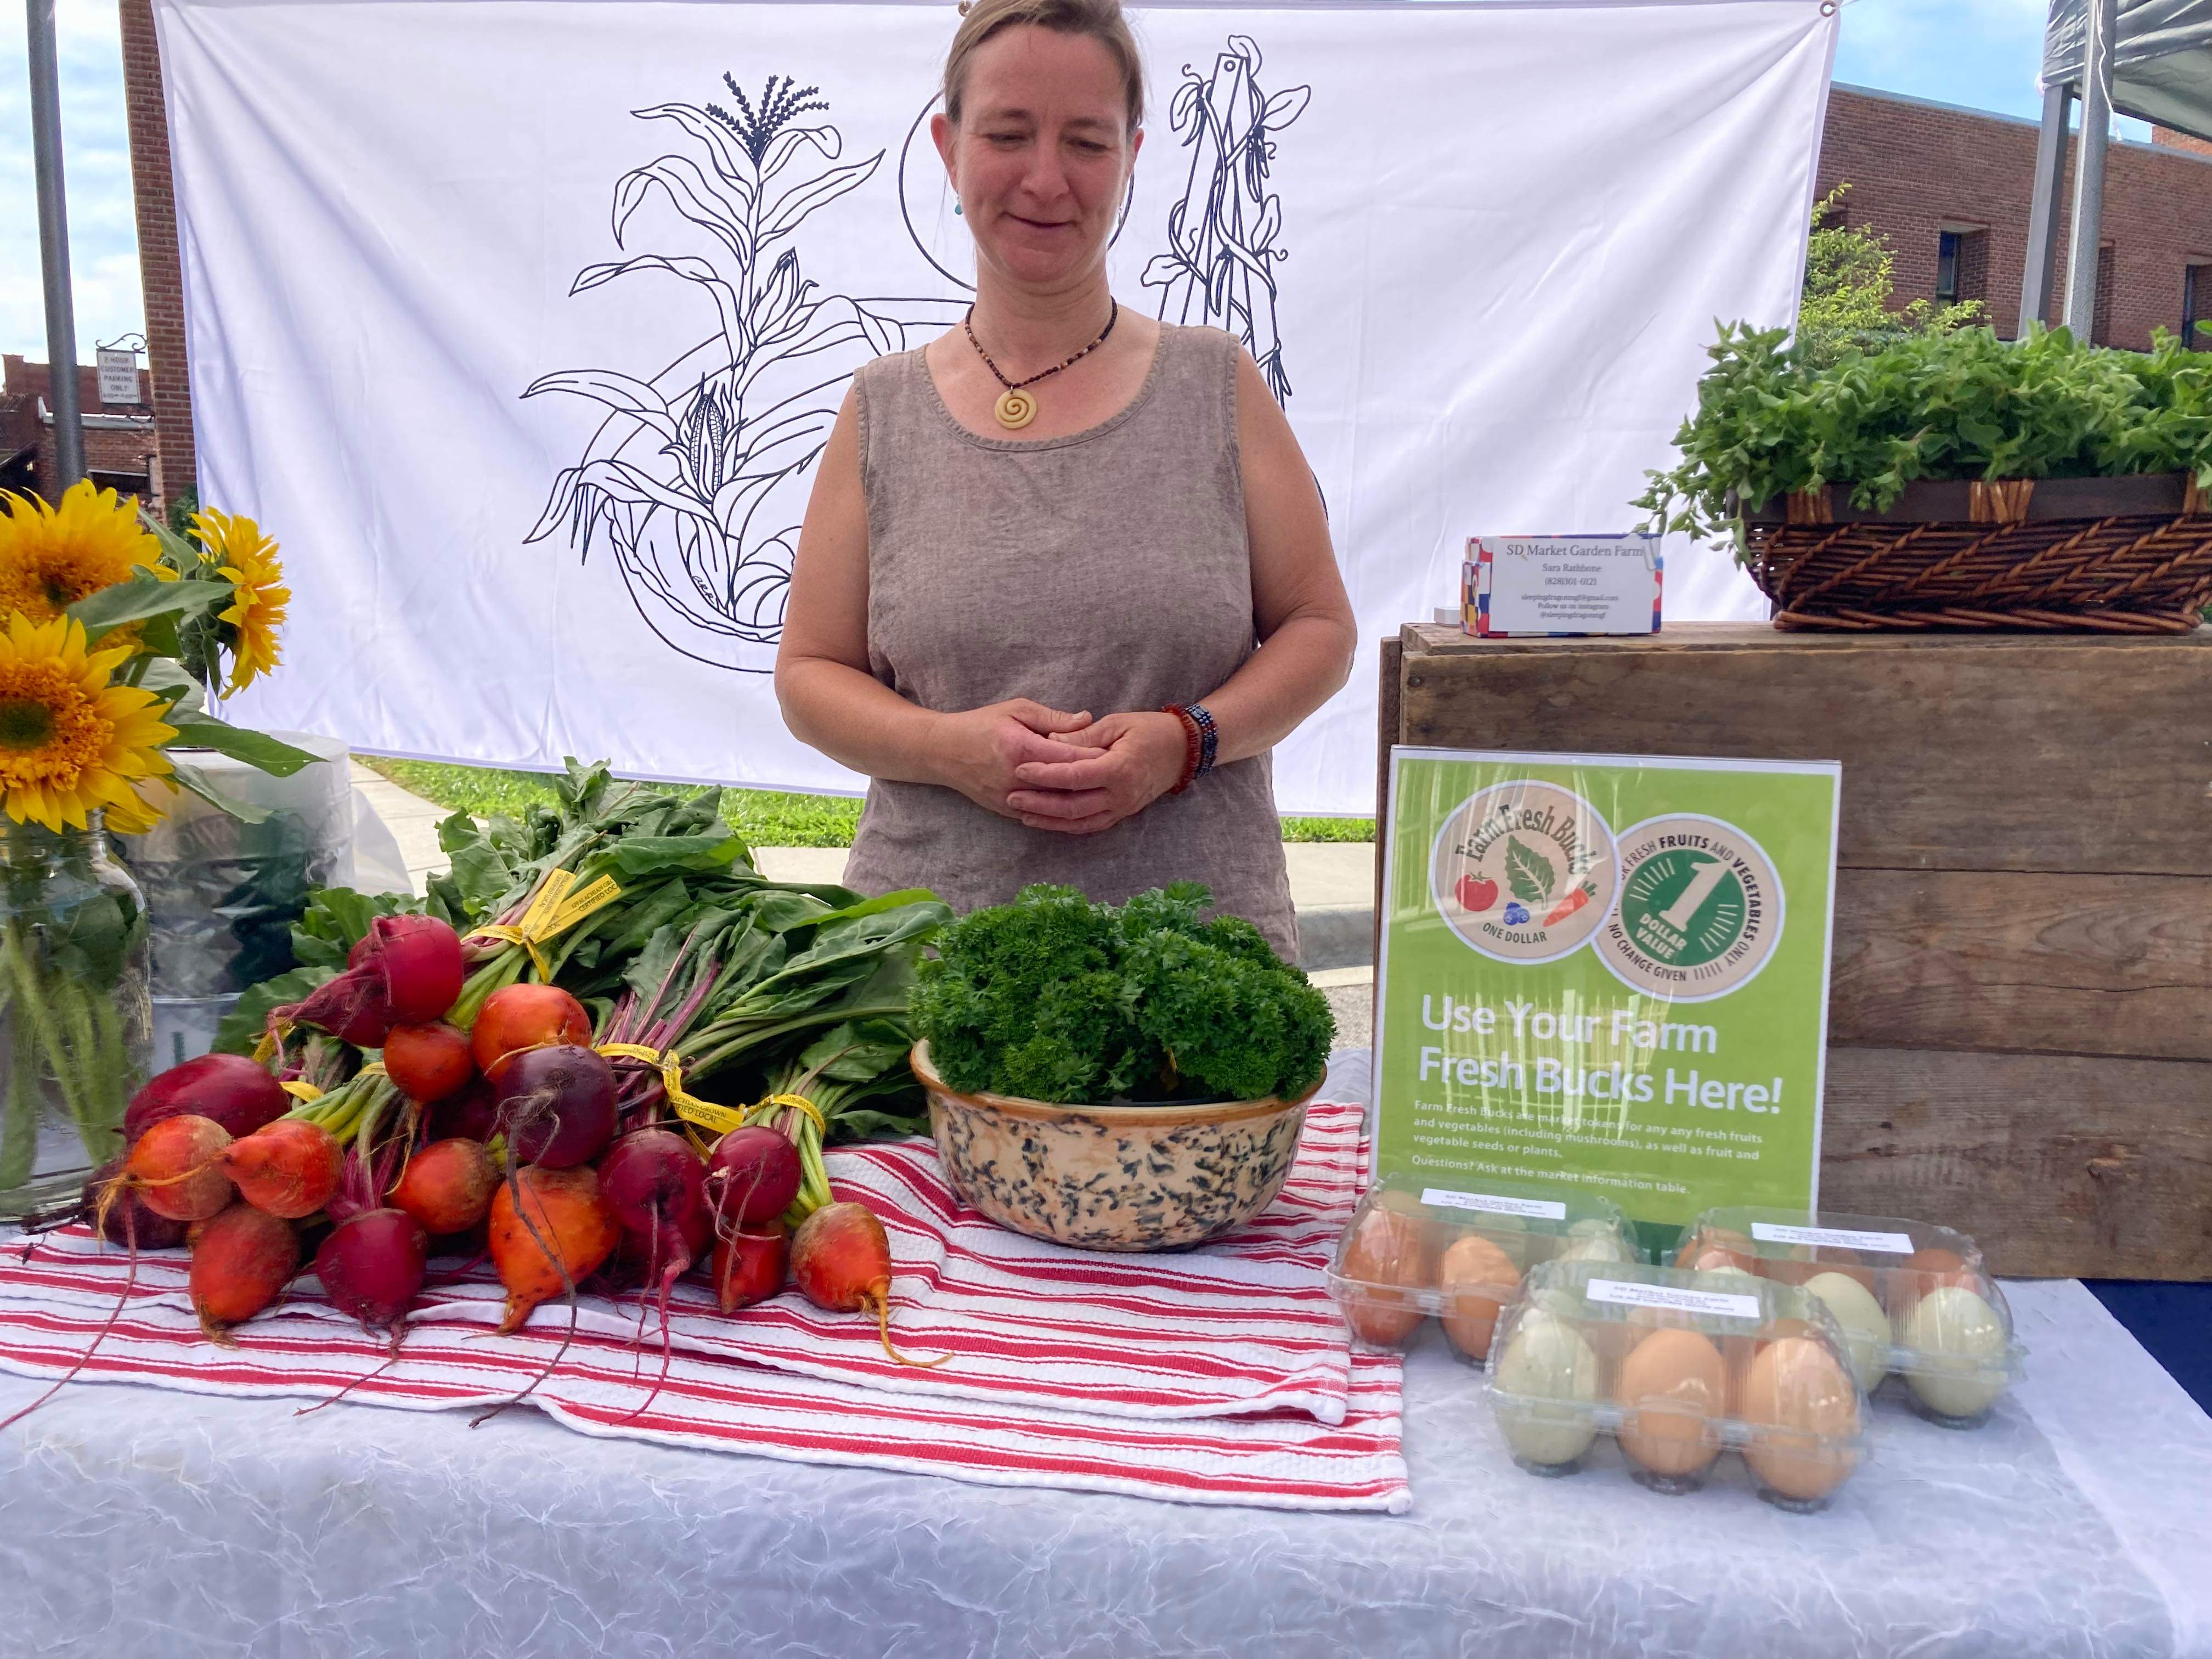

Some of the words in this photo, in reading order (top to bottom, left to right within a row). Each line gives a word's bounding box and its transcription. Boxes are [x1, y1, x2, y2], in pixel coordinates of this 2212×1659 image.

[1506, 544, 1523, 556] SD
[1527, 545, 1567, 556] Market
[1570, 545, 1612, 557] Garden
[1615, 546, 1644, 557] Farm
[1542, 563, 1561, 572] Sara
[1562, 563, 1602, 572] Rathbone
[1455, 818, 1505, 862] Farm
[1499, 804, 1555, 835] Fresh
[1550, 816, 1597, 875] Bucks
[1658, 834, 1709, 849] FRUITS
[1711, 842, 1734, 861] AND
[1624, 840, 1657, 867] FRESH
[570, 885, 604, 909] APPALACHIAN
[578, 891, 606, 912] CERTIFIED
[1658, 861, 1729, 932] 1
[1731, 857, 1763, 941] VEGETABLES
[1483, 923, 1504, 939] ONE
[1505, 931, 1547, 944] DOLLAR
[1635, 927, 1675, 959] VALUE
[1639, 913, 1688, 951] DOLLAR
[1608, 924, 1622, 938] NO
[1617, 940, 1654, 972] CHANGE
[1654, 966, 1686, 981] GIVEN
[1724, 940, 1750, 967] ONLY
[1423, 994, 1496, 1035] Use
[1504, 1001, 1601, 1043] Your
[1611, 1009, 1718, 1054] Farm
[1419, 1046, 1523, 1090] Fresh
[1536, 1056, 1654, 1102] Bucks
[1665, 1068, 1783, 1114] Here!
[695, 1111, 717, 1124] LOCAL
[700, 1105, 727, 1119] GROWN
[1414, 1100, 1443, 1111] Farm
[1446, 1103, 1477, 1115] Fresh
[1480, 1107, 1513, 1119] Bucks
[1516, 1111, 1534, 1120] are
[1582, 1117, 1623, 1130] tokens
[1625, 1120, 1643, 1132] for
[1646, 1125, 1668, 1136] any
[1671, 1126, 1692, 1138] any
[1695, 1127, 1726, 1141] fresh
[1729, 1131, 1763, 1143] fruits
[1413, 1133, 1469, 1147] vegetable
[1472, 1140, 1504, 1151] seeds
[1522, 1144, 1563, 1158] plants.
[1414, 1118, 1435, 1128] and
[1438, 1120, 1500, 1135] vegetables
[1503, 1126, 1562, 1143] (including
[1565, 1132, 1643, 1150] mushrooms),
[1645, 1141, 1659, 1150] as
[1662, 1142, 1687, 1153] well
[1690, 1146, 1703, 1155] as
[1706, 1145, 1733, 1158] fruit
[1736, 1150, 1760, 1160] and
[1412, 1155, 1474, 1170] Questions?
[1476, 1162, 1498, 1173] Ask
[1500, 1166, 1511, 1175] at
[1515, 1167, 1534, 1177] the
[1538, 1170, 1578, 1182] market
[1581, 1173, 1653, 1190] information
[1656, 1182, 1690, 1194] table.
